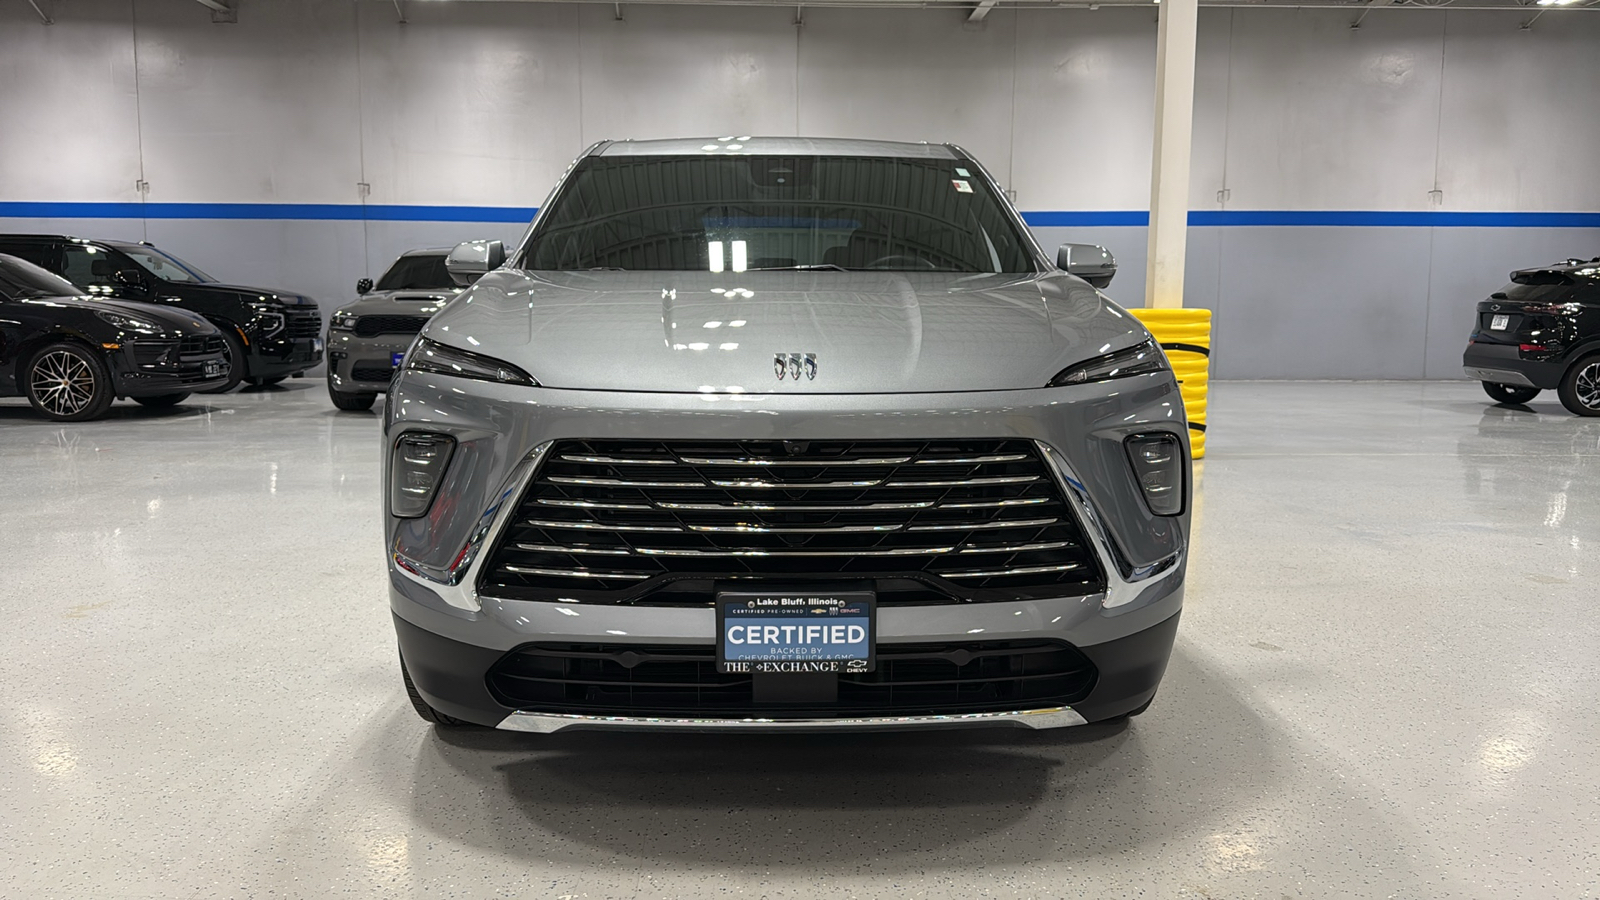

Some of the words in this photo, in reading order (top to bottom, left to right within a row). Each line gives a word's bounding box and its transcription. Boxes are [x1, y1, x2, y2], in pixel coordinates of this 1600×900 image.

[757, 598, 779, 606] Lake
[781, 598, 806, 606] Bluff,
[808, 597, 838, 605] Illinois
[727, 625, 865, 645] CERTIFIED
[770, 647, 808, 655] BACKED
[723, 661, 750, 672] THE
[763, 661, 839, 672] EXCHANGE
